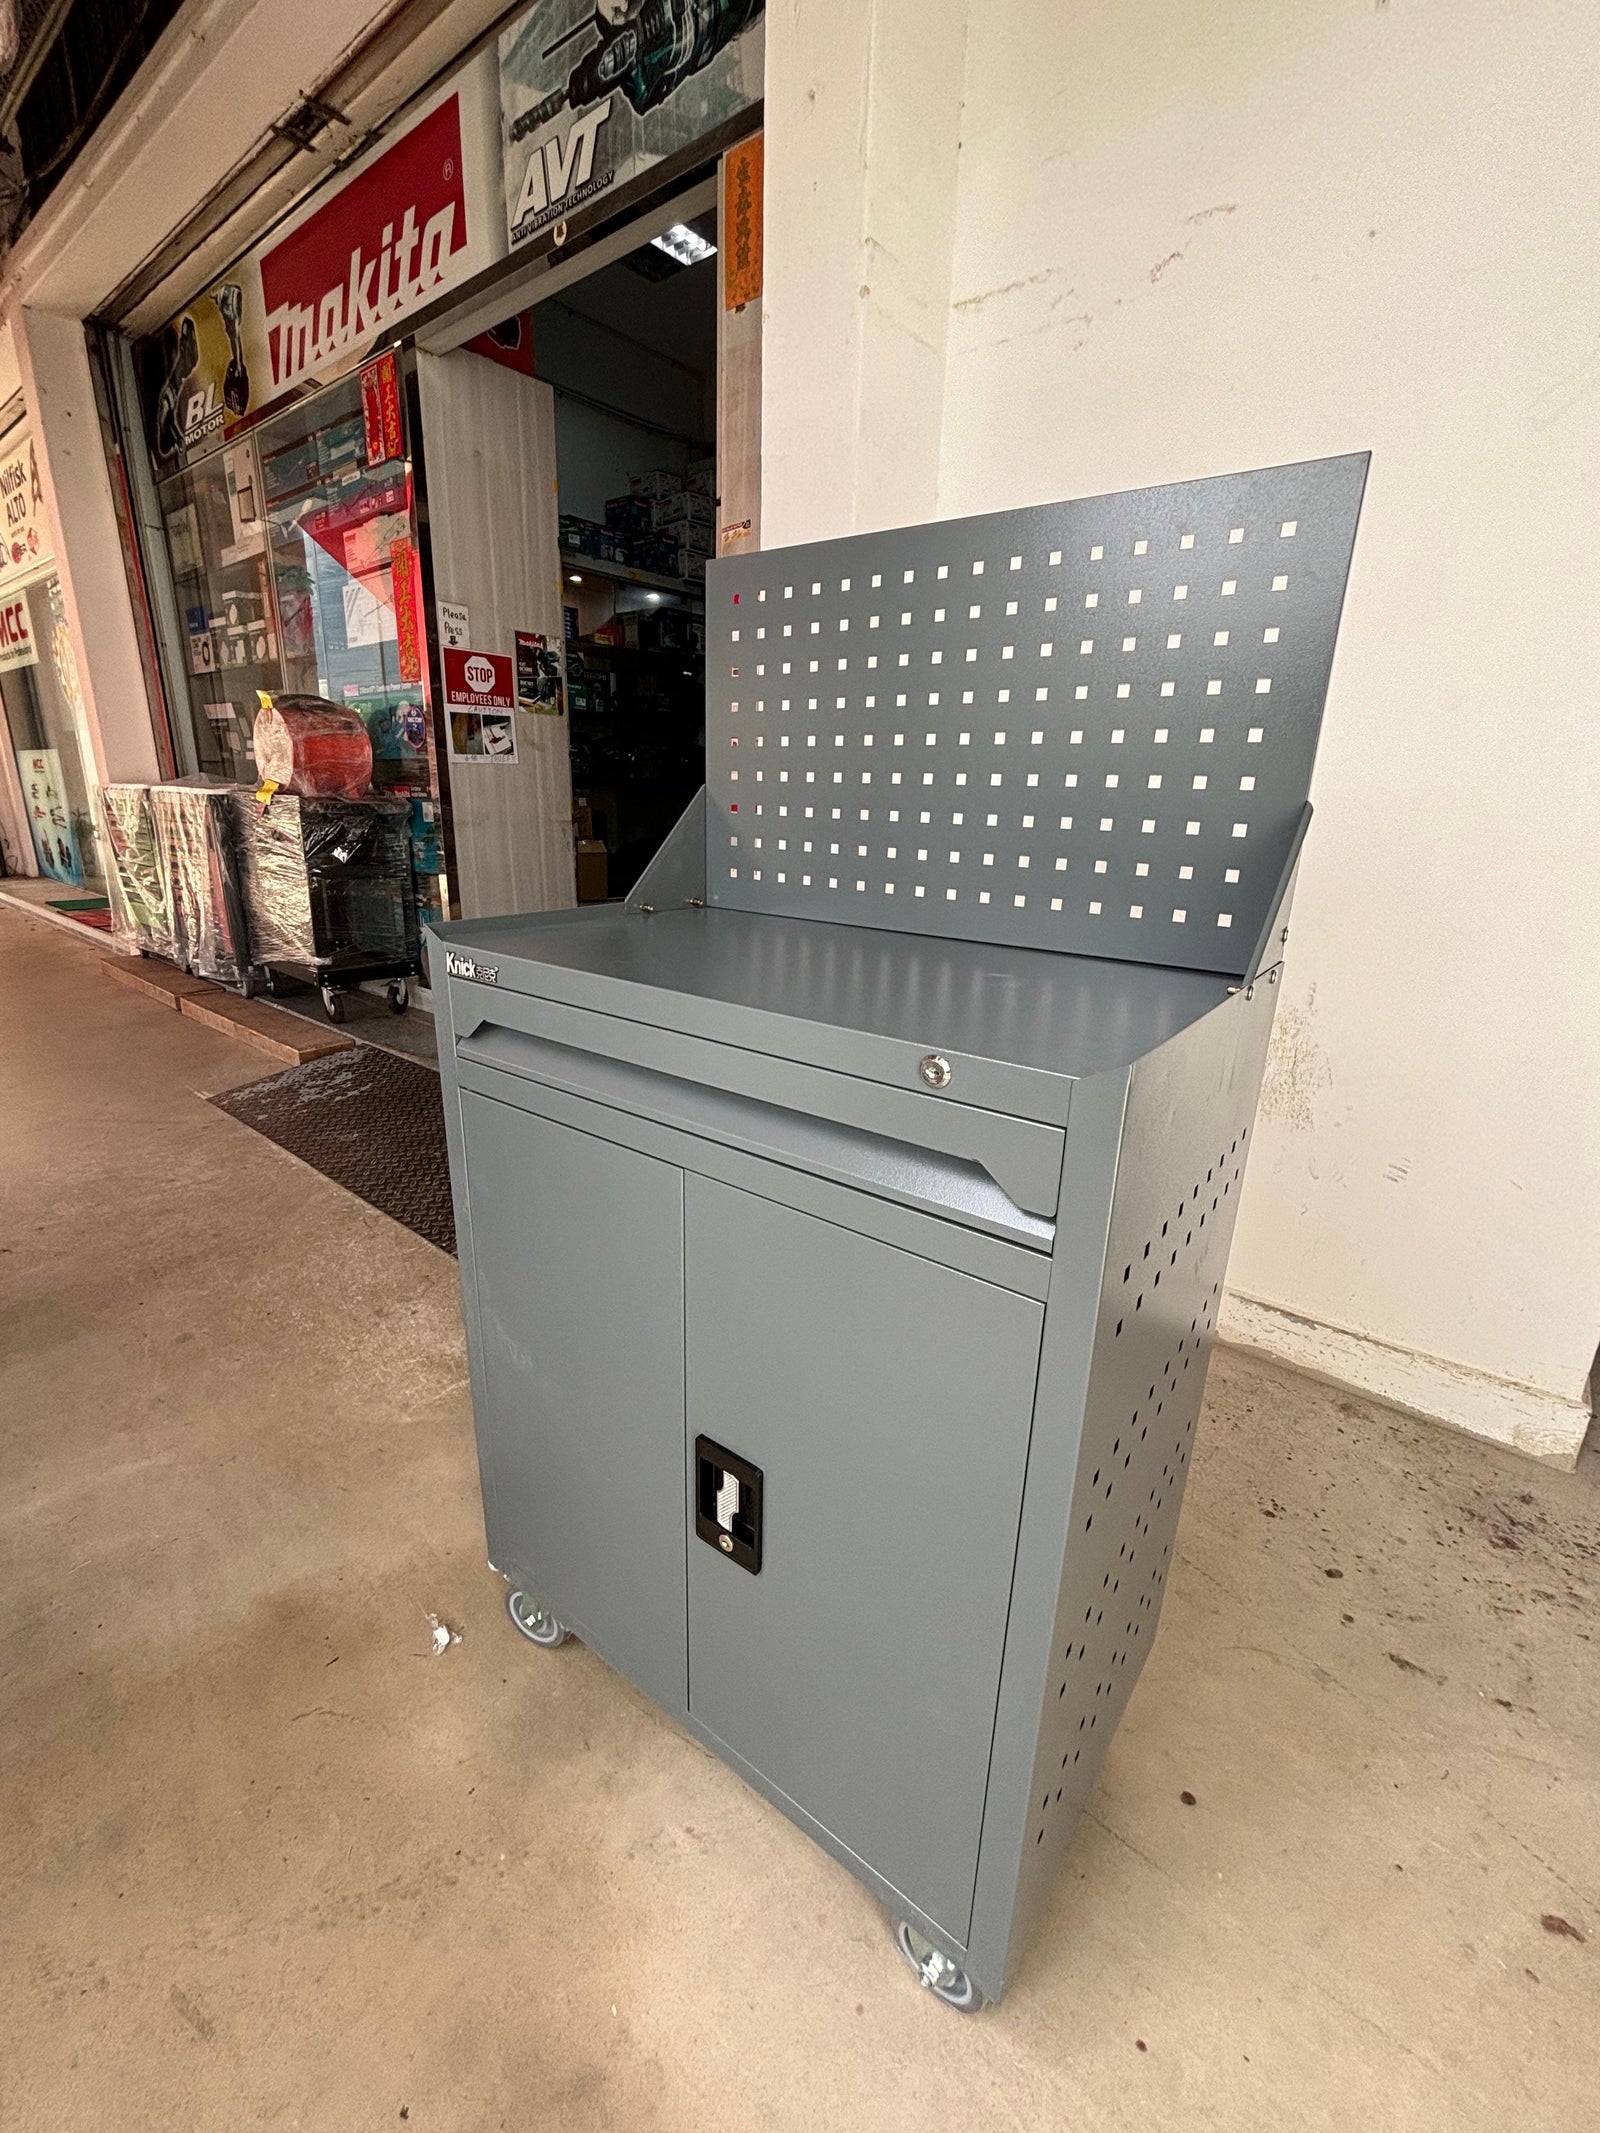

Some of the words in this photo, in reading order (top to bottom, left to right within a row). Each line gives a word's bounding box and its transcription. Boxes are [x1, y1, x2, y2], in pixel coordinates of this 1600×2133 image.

[511, 96, 611, 231] AVT
[527, 202, 564, 234] VIBRATION
[565, 169, 615, 211] TECHNOLOGY
[266, 201, 456, 386] makita
[185, 382, 223, 430] BL
[184, 414, 225, 446] MOTOR
[0, 459, 27, 499] Nilfisk
[6, 492, 26, 528] ALTO
[442, 606, 467, 621] Please
[467, 665, 493, 683] STOP
[584, 672, 606, 680] ITACHI
[451, 690, 492, 705] EMPLOYEES
[493, 695, 511, 707] ONLY
[446, 951, 475, 978] Knick
